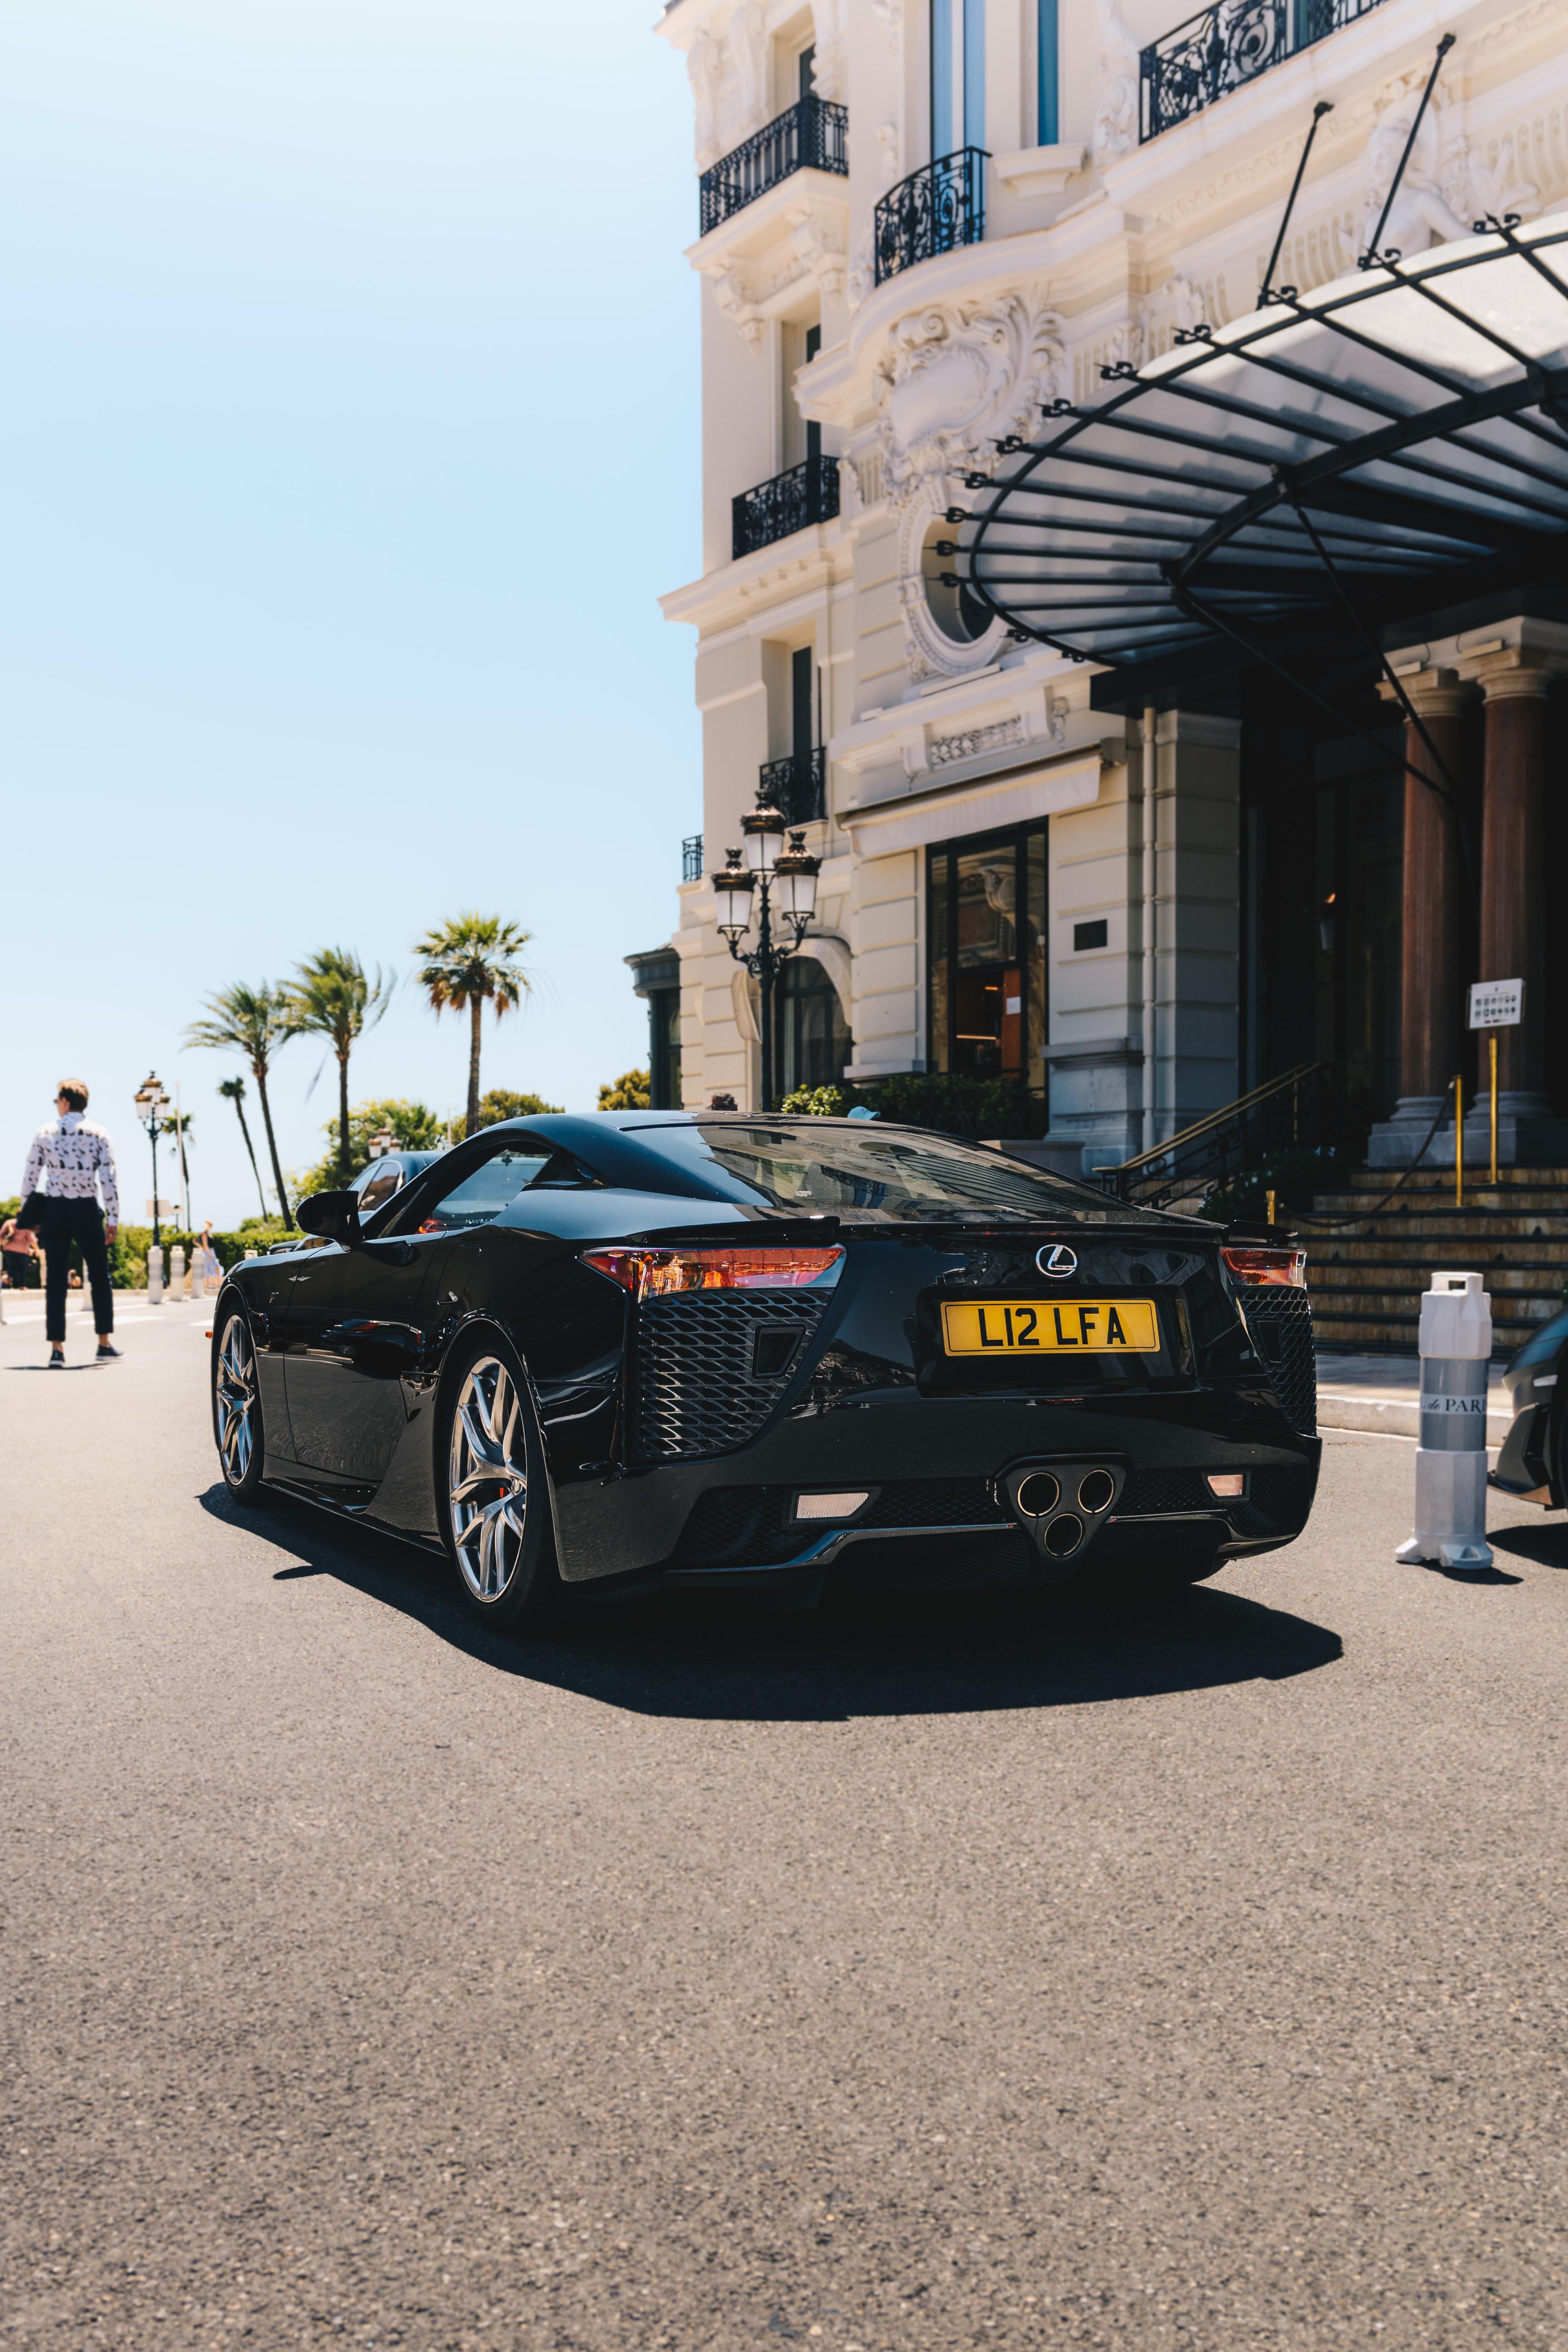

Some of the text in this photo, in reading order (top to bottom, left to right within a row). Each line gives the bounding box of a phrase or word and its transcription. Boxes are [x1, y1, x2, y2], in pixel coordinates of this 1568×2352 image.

[978, 1307, 1127, 1347] L12 LFA
[1427, 1398, 1441, 1410] de
[1445, 1398, 1487, 1413] PARI
